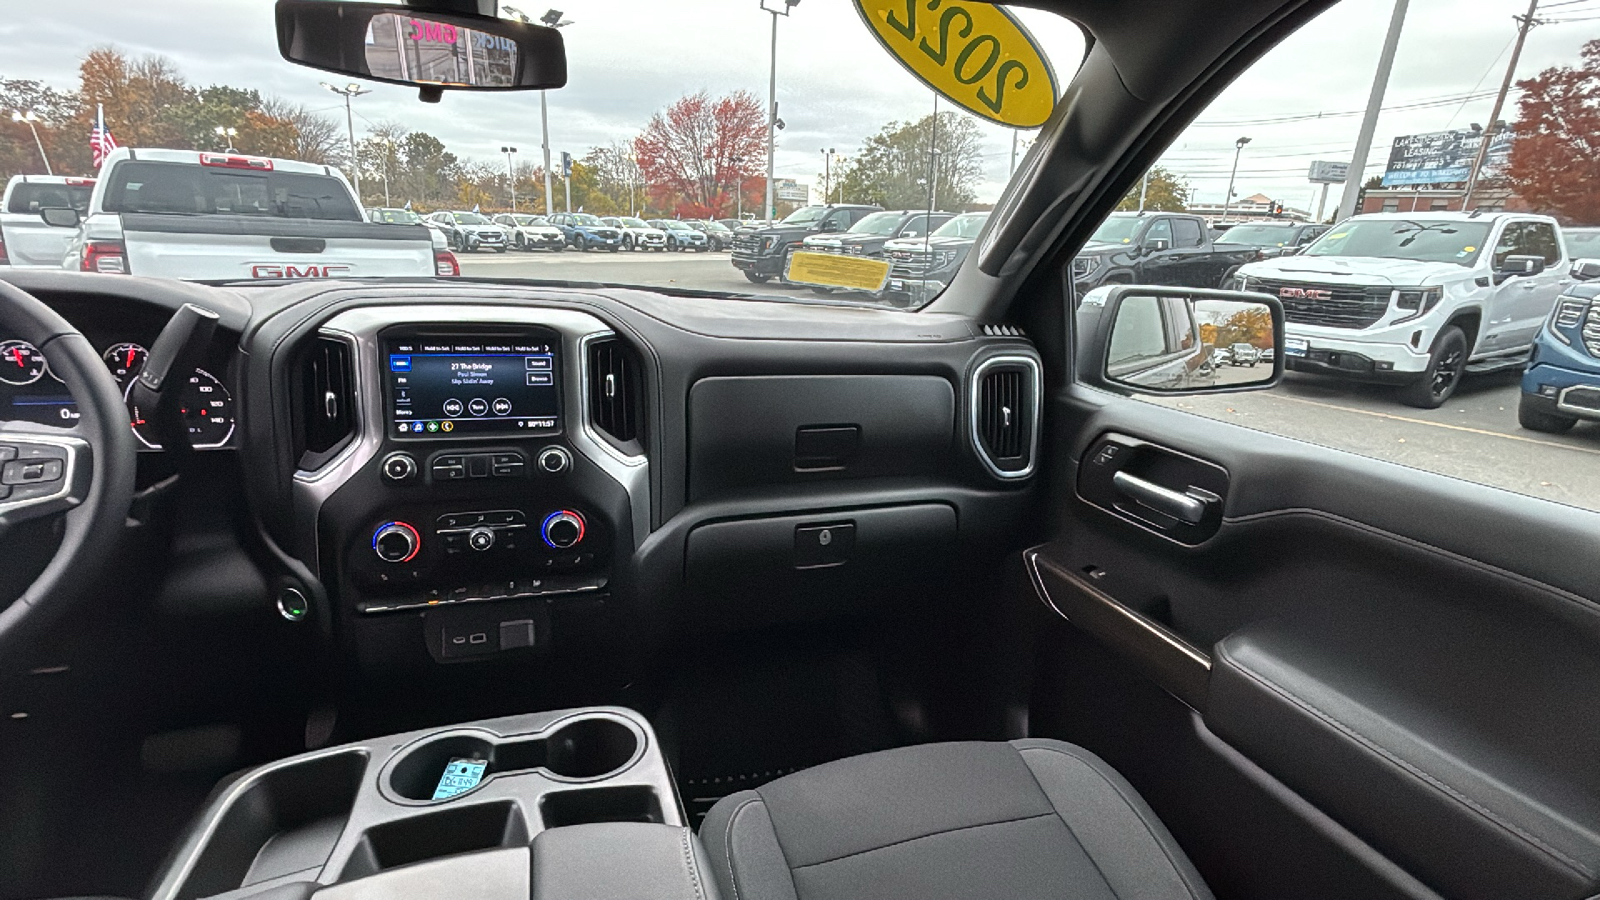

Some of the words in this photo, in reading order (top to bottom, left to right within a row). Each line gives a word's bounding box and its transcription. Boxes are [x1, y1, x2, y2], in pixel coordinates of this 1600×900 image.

[1404, 147, 1438, 157] LEASING
[252, 265, 350, 279] GMC
[1279, 287, 1332, 300] GMC
[472, 363, 493, 371] Bridge
